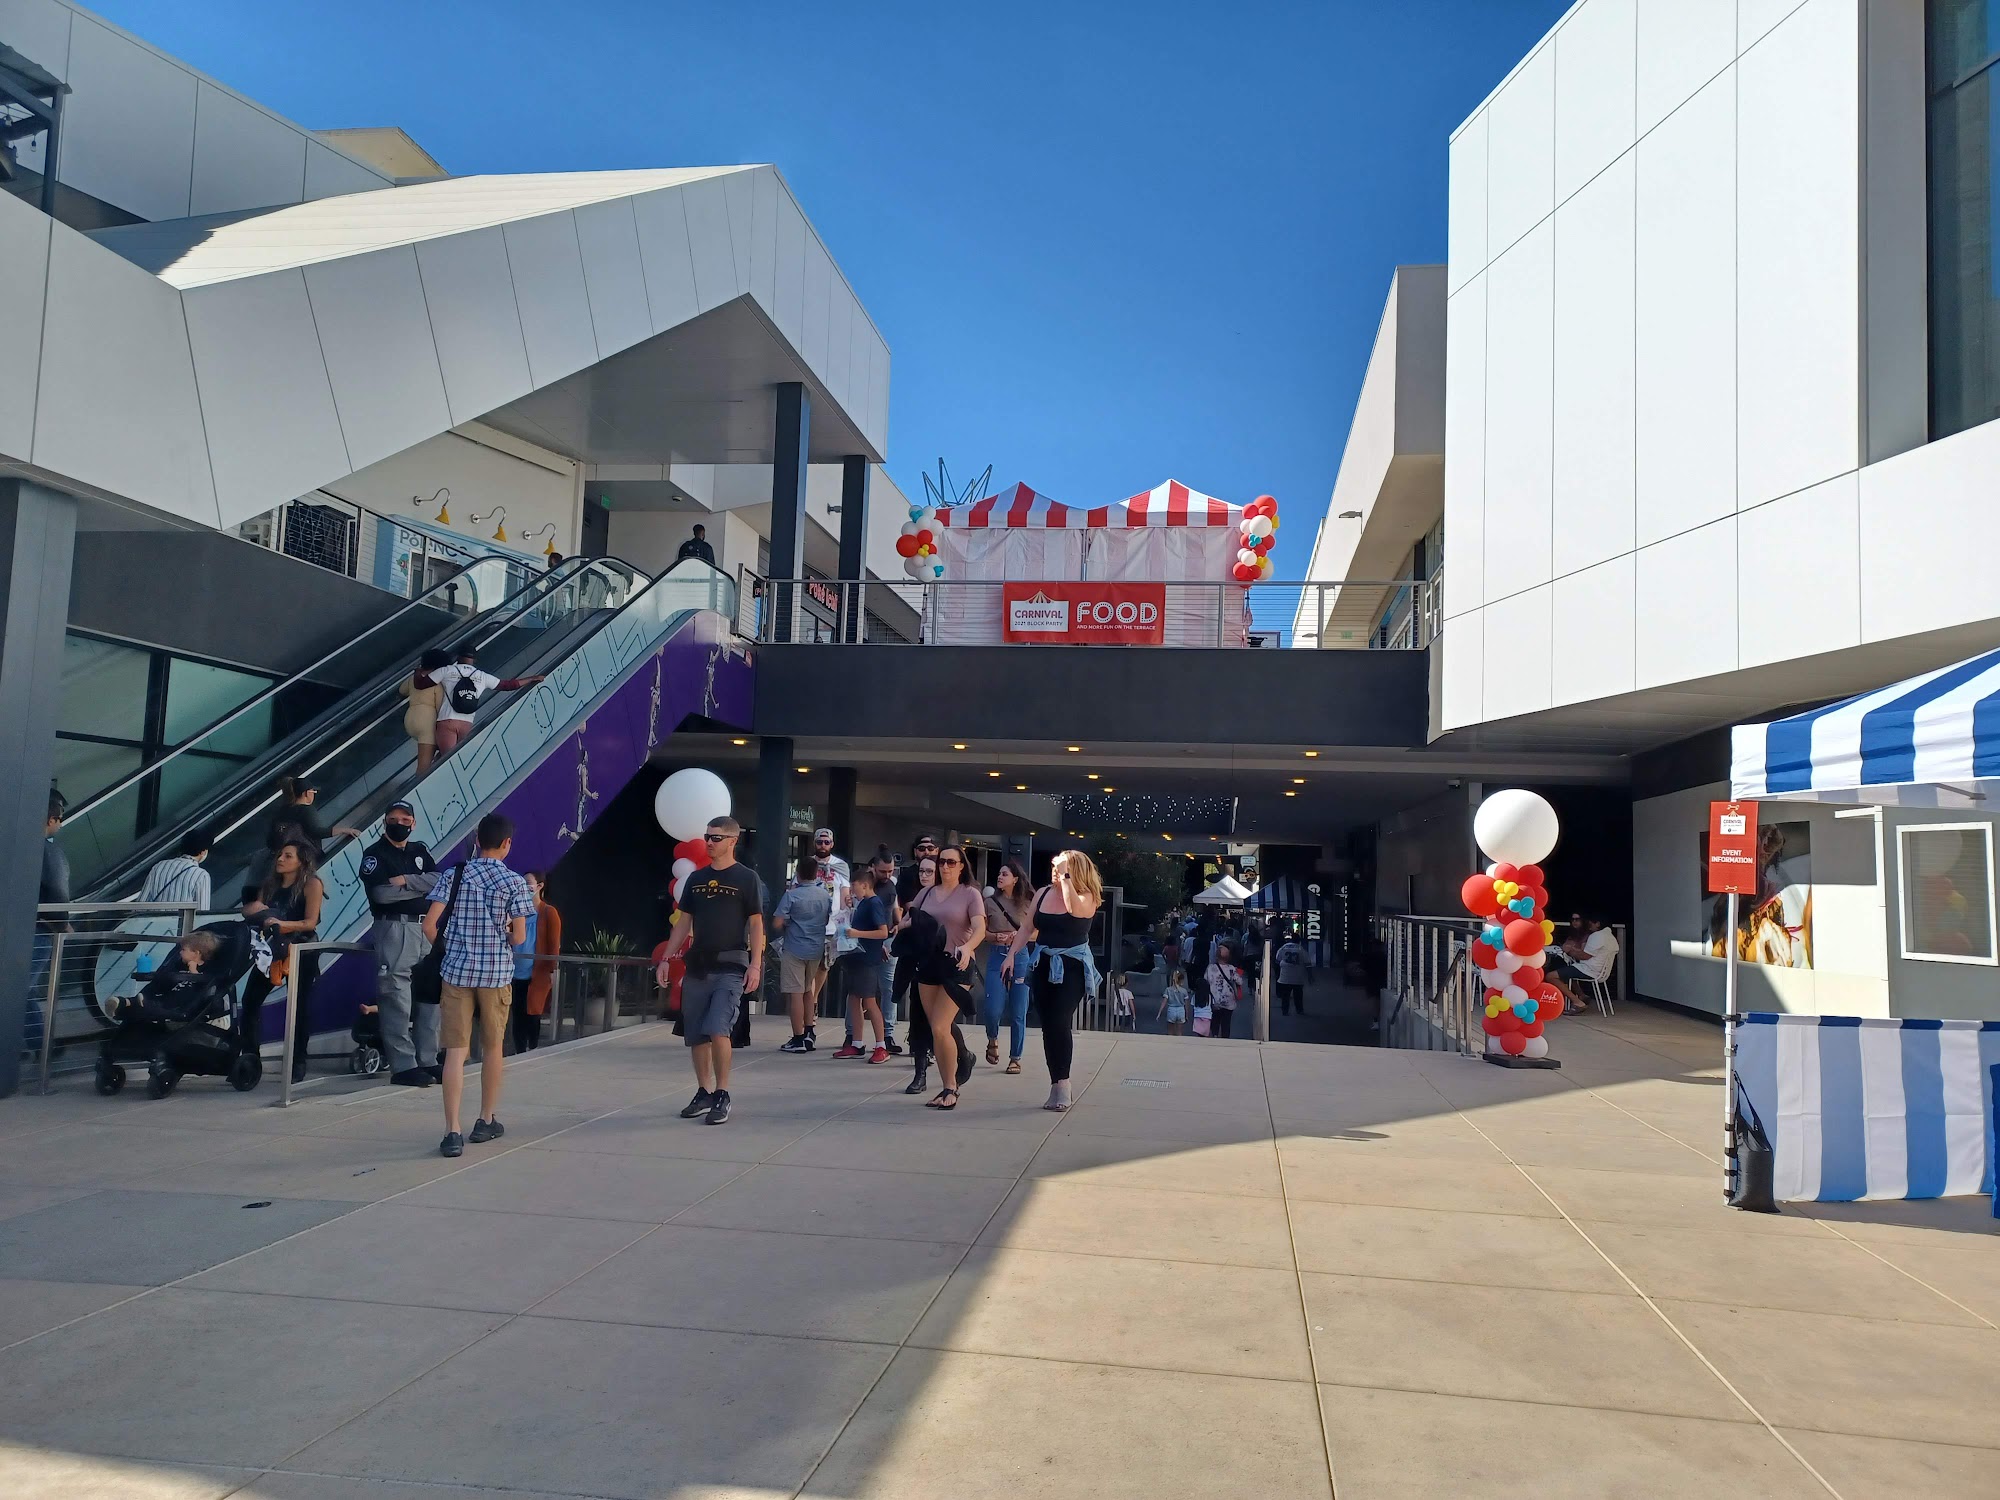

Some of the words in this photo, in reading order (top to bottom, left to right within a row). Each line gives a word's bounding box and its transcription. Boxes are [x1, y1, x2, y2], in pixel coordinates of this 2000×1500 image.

[1015, 610, 1063, 619] CARNIVAL
[1077, 602, 1157, 623] FOOD
[1711, 856, 1753, 864] INFORMATION
